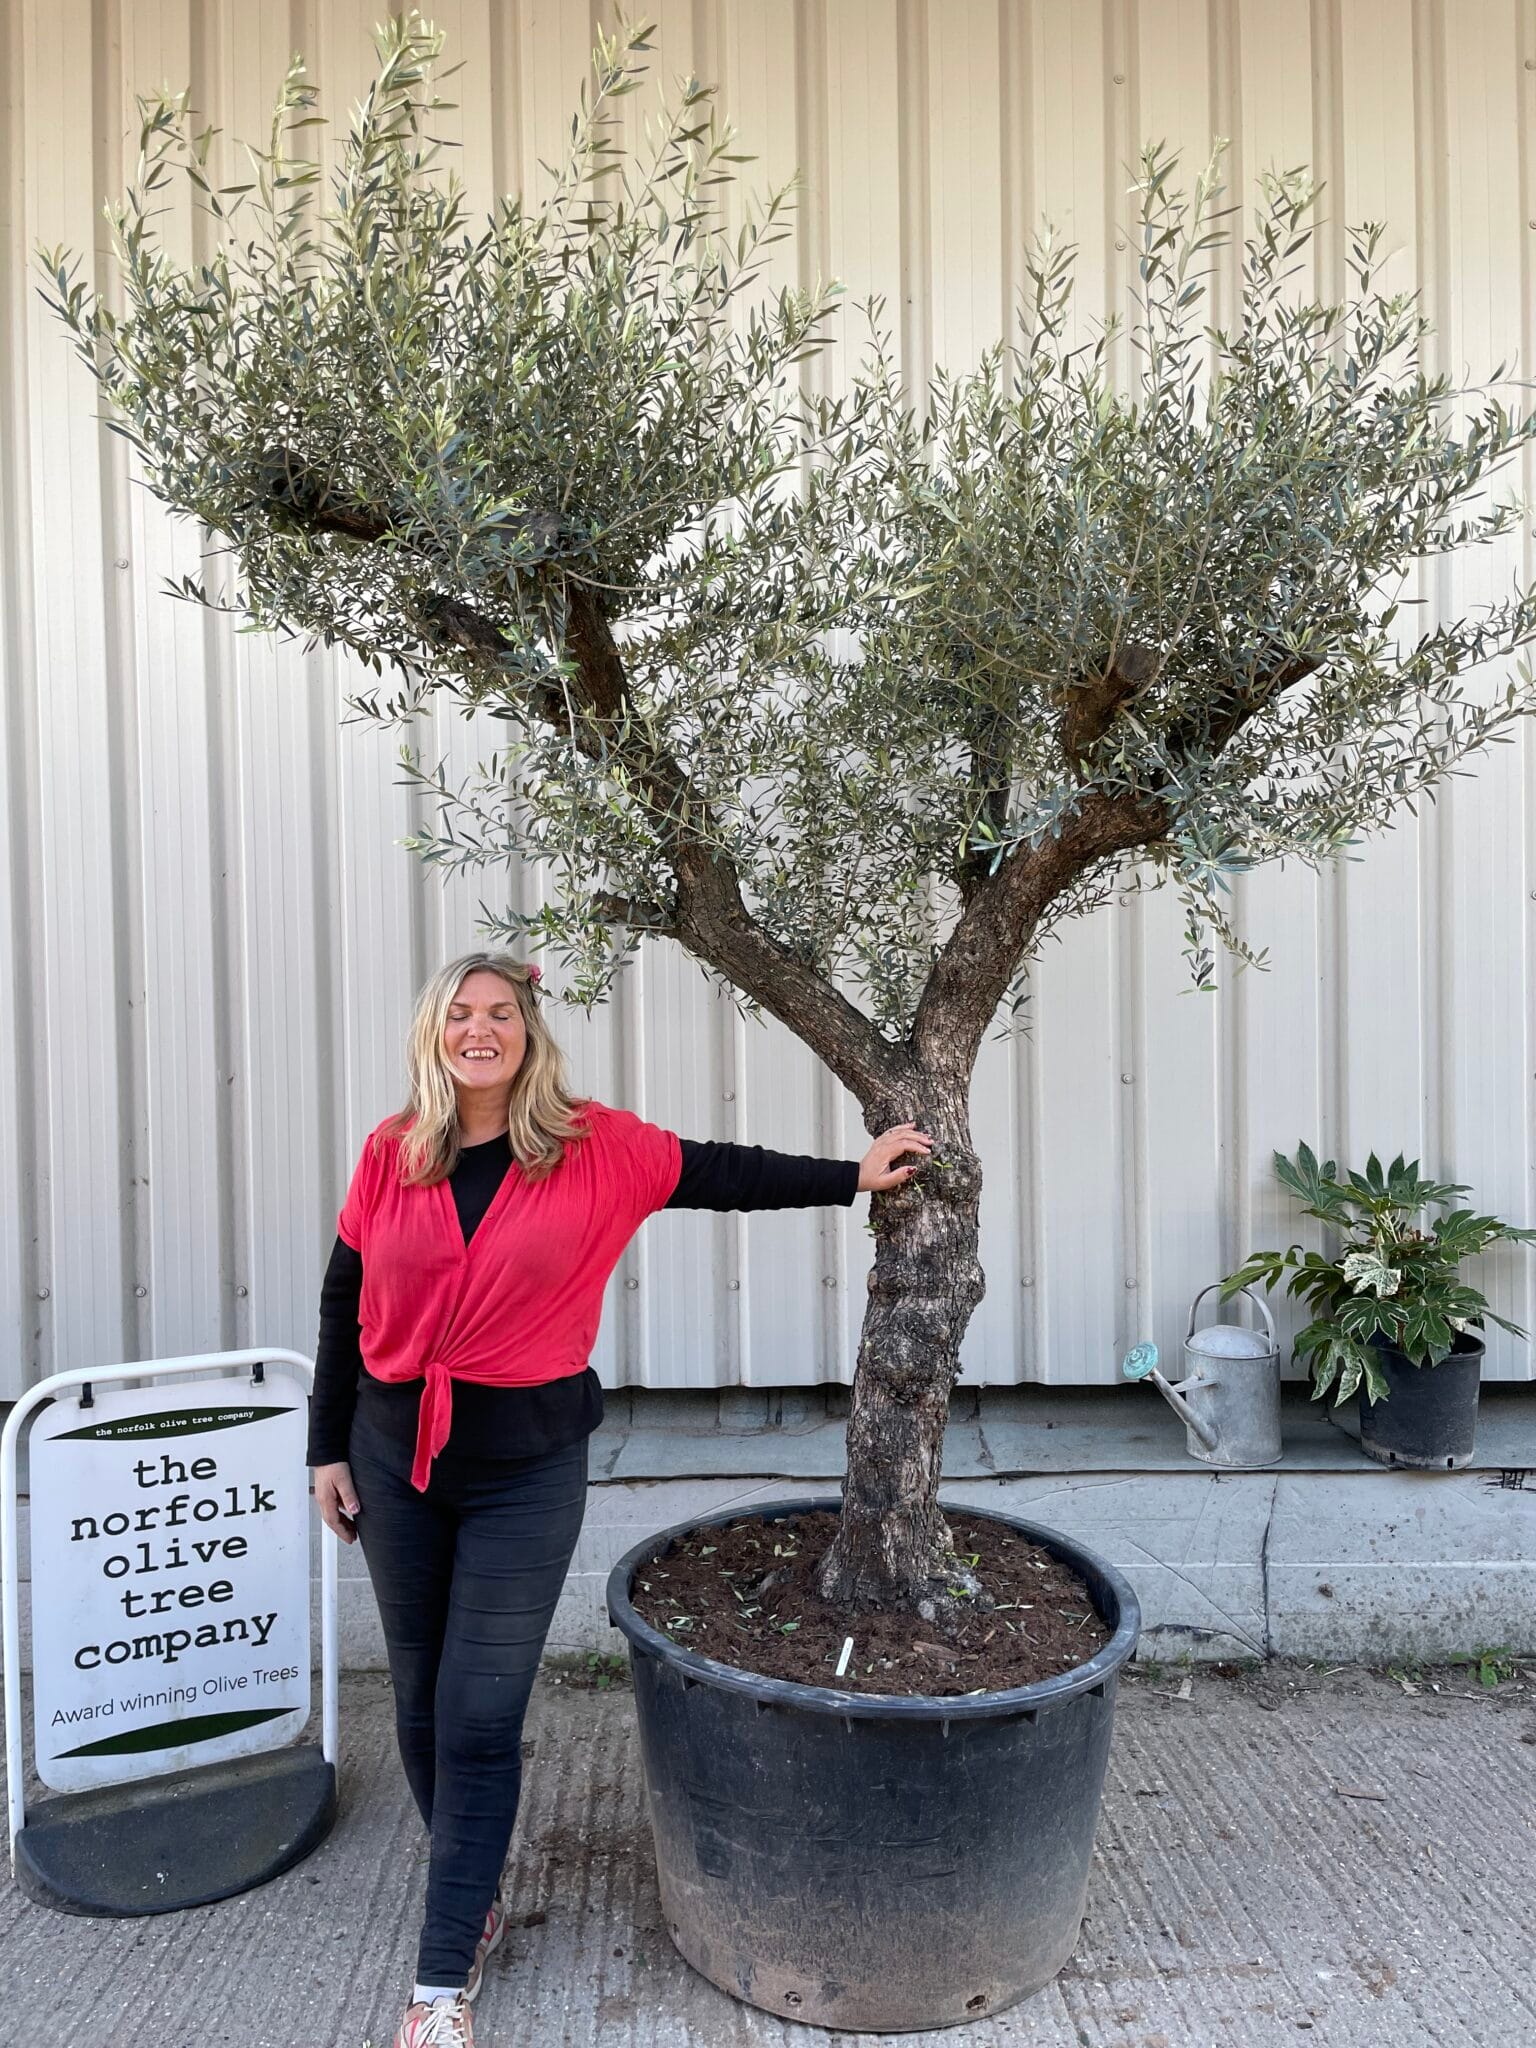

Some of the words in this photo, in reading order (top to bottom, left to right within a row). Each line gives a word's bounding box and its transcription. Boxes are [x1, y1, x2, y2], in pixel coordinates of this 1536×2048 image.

[95, 1428, 112, 1437] the
[117, 1422, 156, 1434] norfolk
[160, 1418, 187, 1429] olive
[192, 1415, 213, 1424] tree
[217, 1410, 254, 1422] company
[133, 1455, 217, 1488] the
[71, 1484, 277, 1541] norfolk
[103, 1536, 248, 1579] olive
[121, 1580, 234, 1618] tree
[74, 1612, 278, 1670] company
[51, 1699, 114, 1727] Award
[120, 1685, 197, 1712] winning
[202, 1675, 248, 1696] Olive
[253, 1665, 299, 1686] Trees
